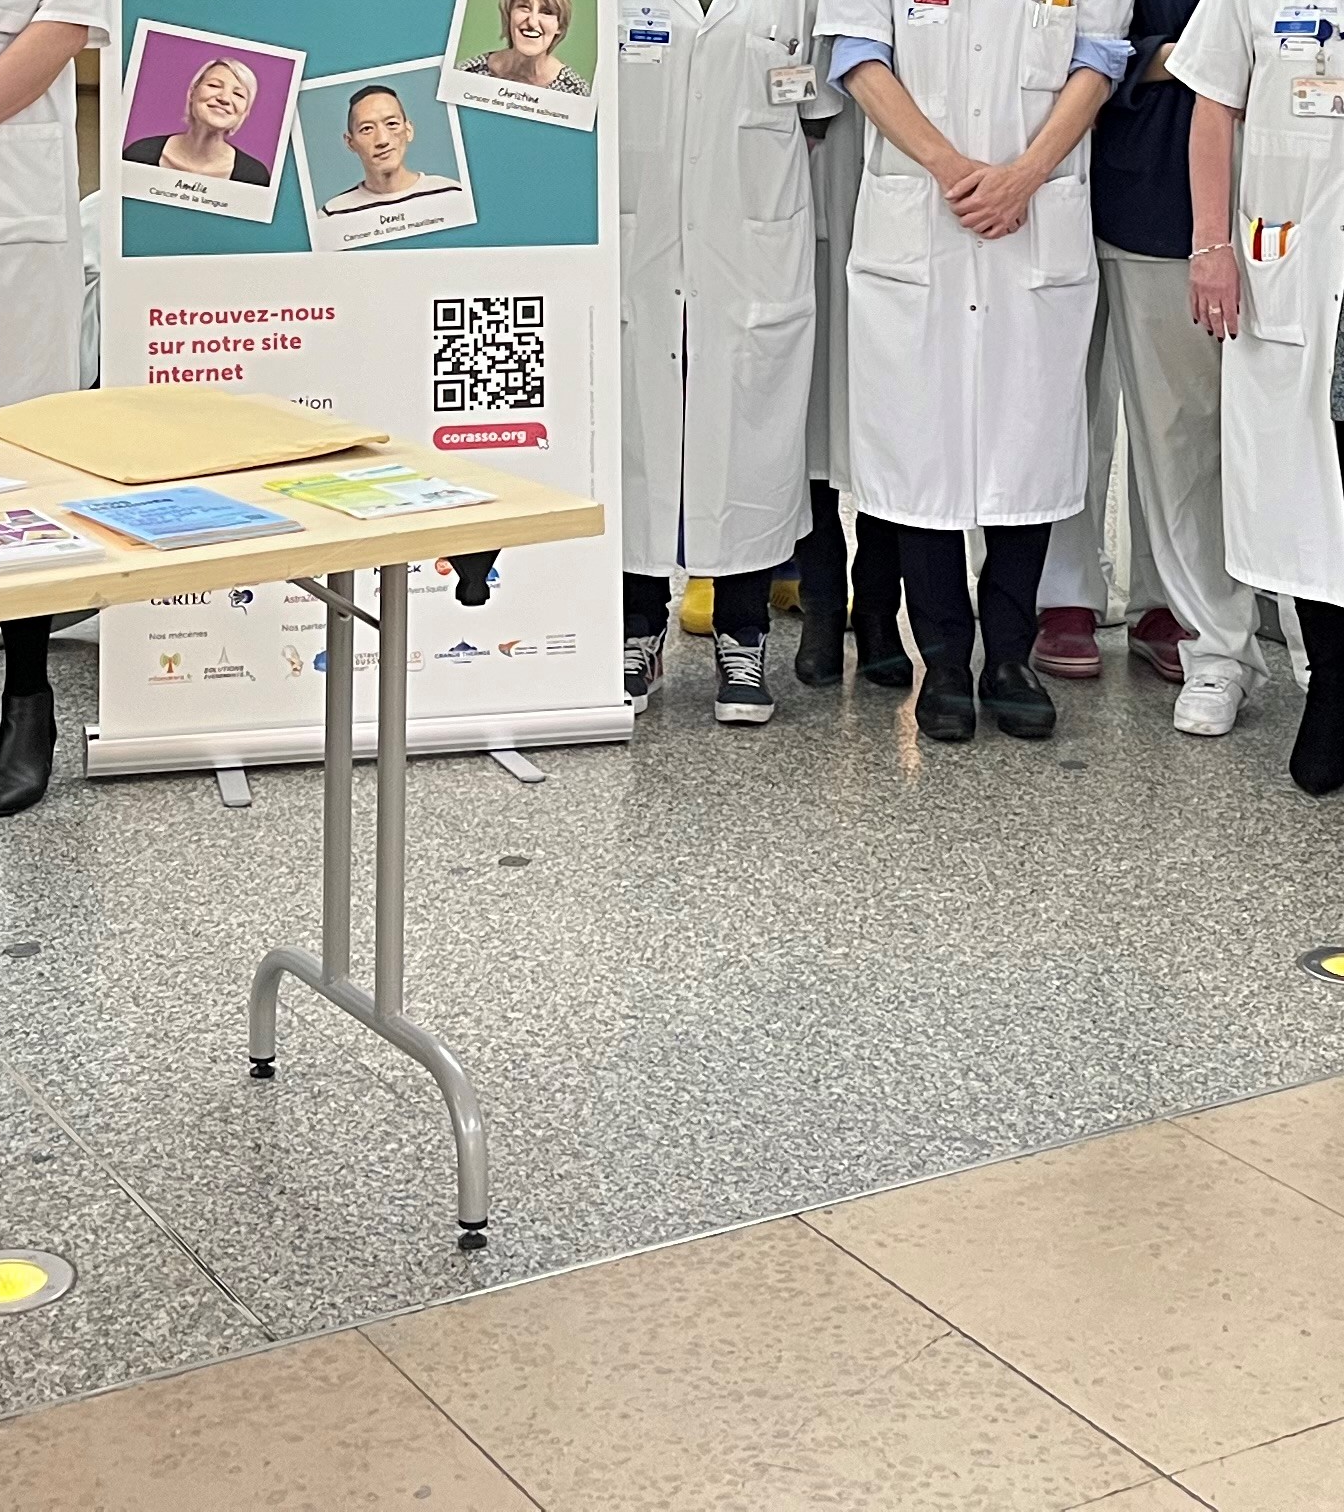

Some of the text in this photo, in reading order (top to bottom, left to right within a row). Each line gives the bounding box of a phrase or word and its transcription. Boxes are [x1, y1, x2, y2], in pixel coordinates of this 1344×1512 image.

[463, 92, 490, 104] Cancer
[492, 98, 505, 107] des
[149, 187, 178, 198] Cancer
[343, 231, 371, 242] Cancer
[148, 306, 336, 326] Retrouvez-nous
[148, 333, 303, 356] sur notre site
[148, 364, 244, 384] internet
[441, 430, 527, 444] corasso.org
